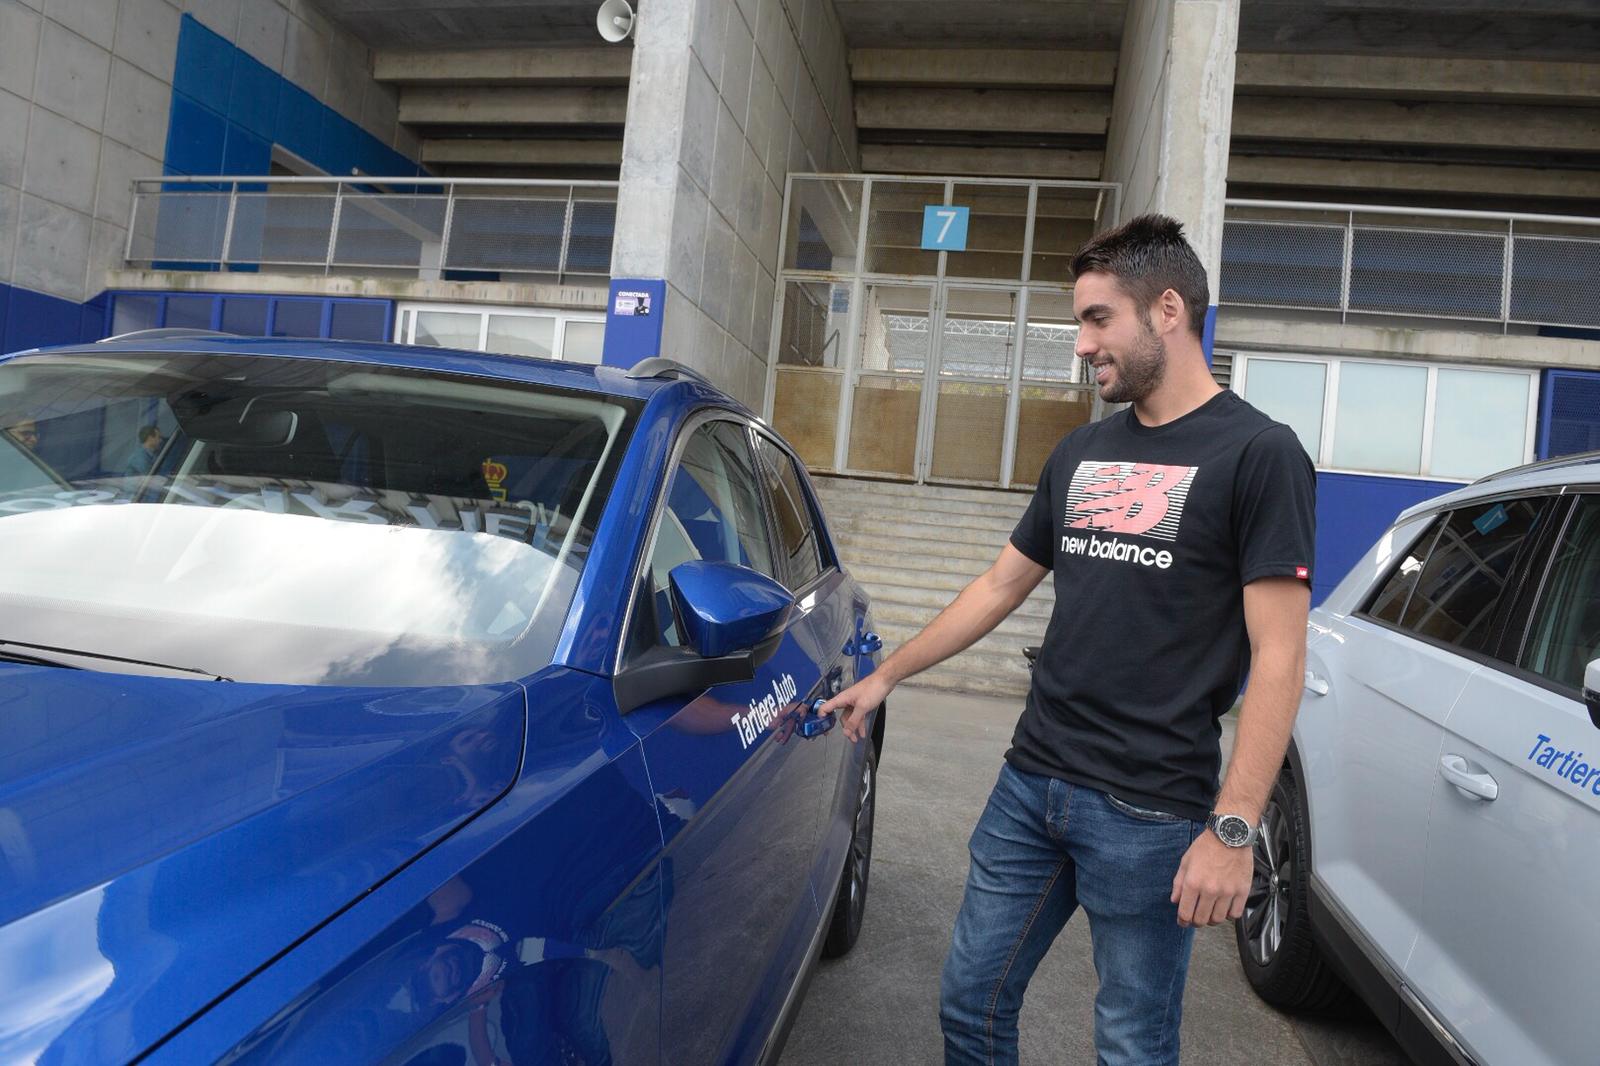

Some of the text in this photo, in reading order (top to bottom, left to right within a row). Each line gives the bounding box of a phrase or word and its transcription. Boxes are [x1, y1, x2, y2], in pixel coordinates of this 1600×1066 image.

[936, 211, 957, 243] 7
[1061, 534, 1173, 569] new balance
[730, 672, 797, 750] Tartiere Auto
